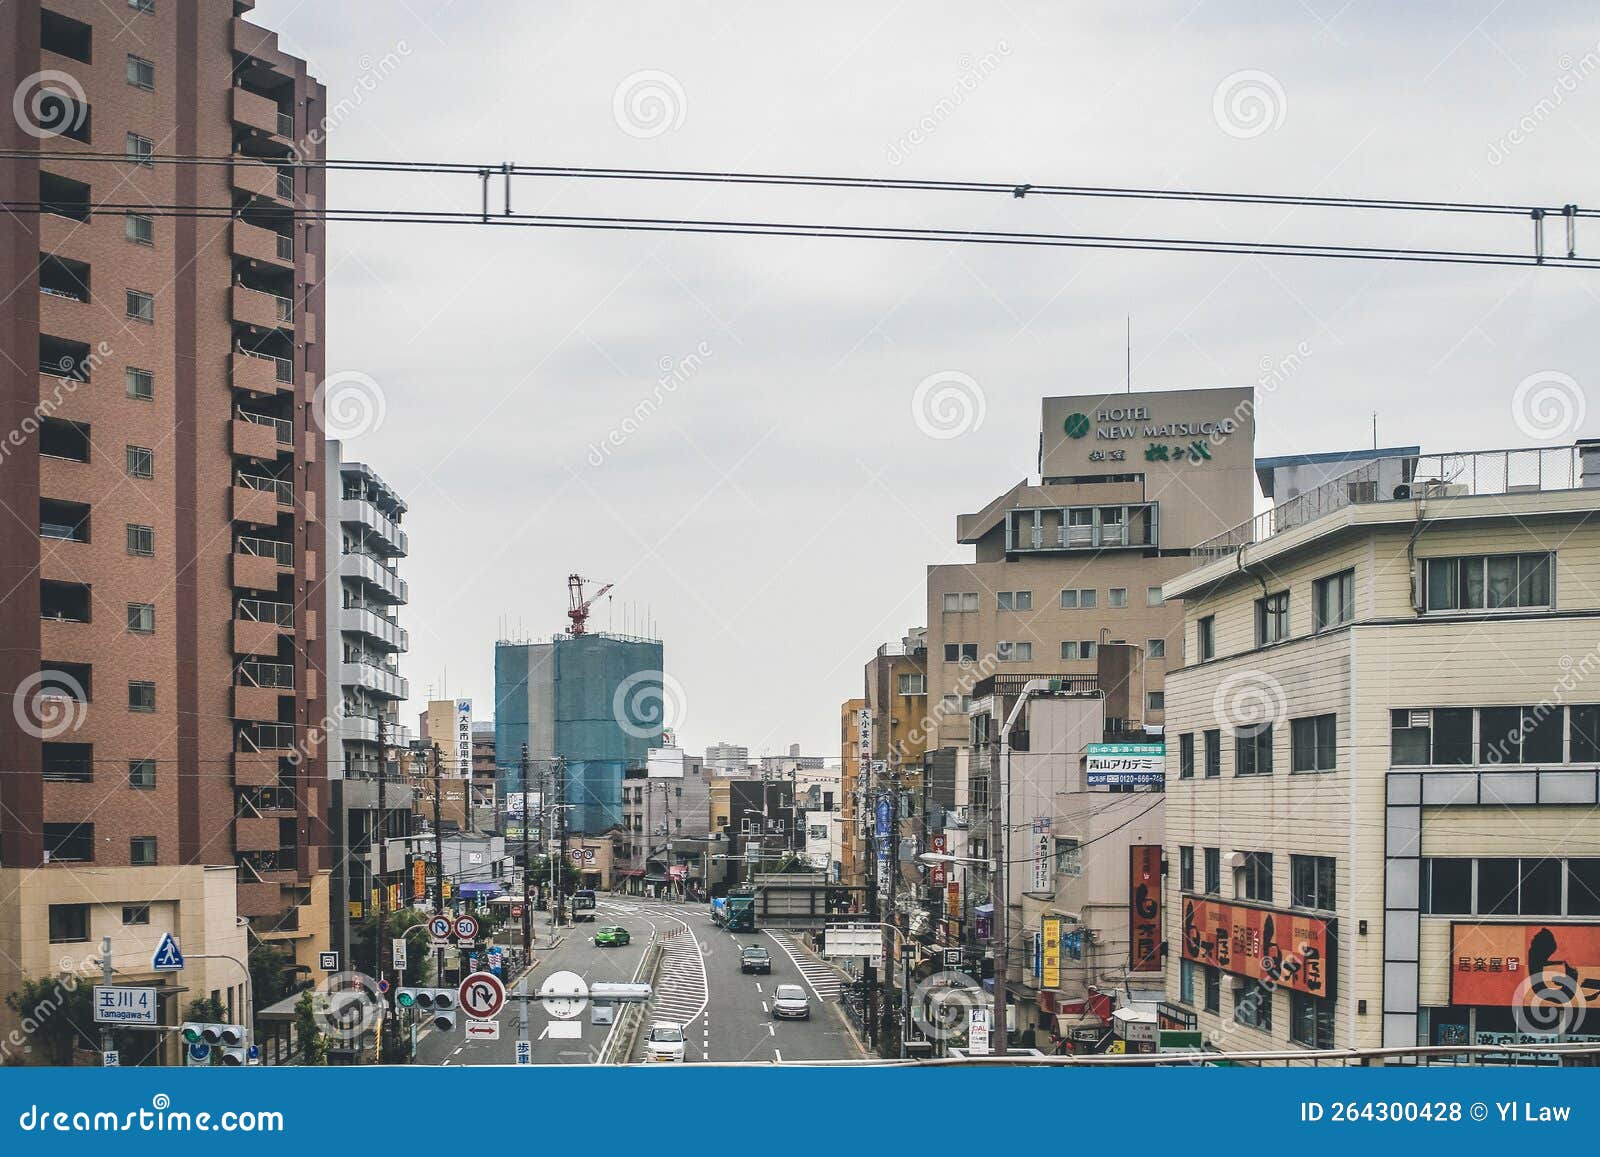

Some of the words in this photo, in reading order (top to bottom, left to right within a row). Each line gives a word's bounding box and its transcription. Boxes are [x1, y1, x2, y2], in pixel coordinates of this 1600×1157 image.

[1097, 408, 1151, 422] HOTEL
[1097, 425, 1136, 439] NEW
[1143, 421, 1233, 437] MATSUGAE
[1089, 759, 1162, 770] 青山アカデミー
[460, 922, 473, 933] 50
[1458, 957, 1503, 972] 居楽屋
[100, 991, 133, 1007] 玉川
[139, 992, 148, 1008] 4
[100, 1009, 151, 1019] Tamagawa-4
[105, 1053, 117, 1066] 歩
[517, 1042, 530, 1064] 歩車
